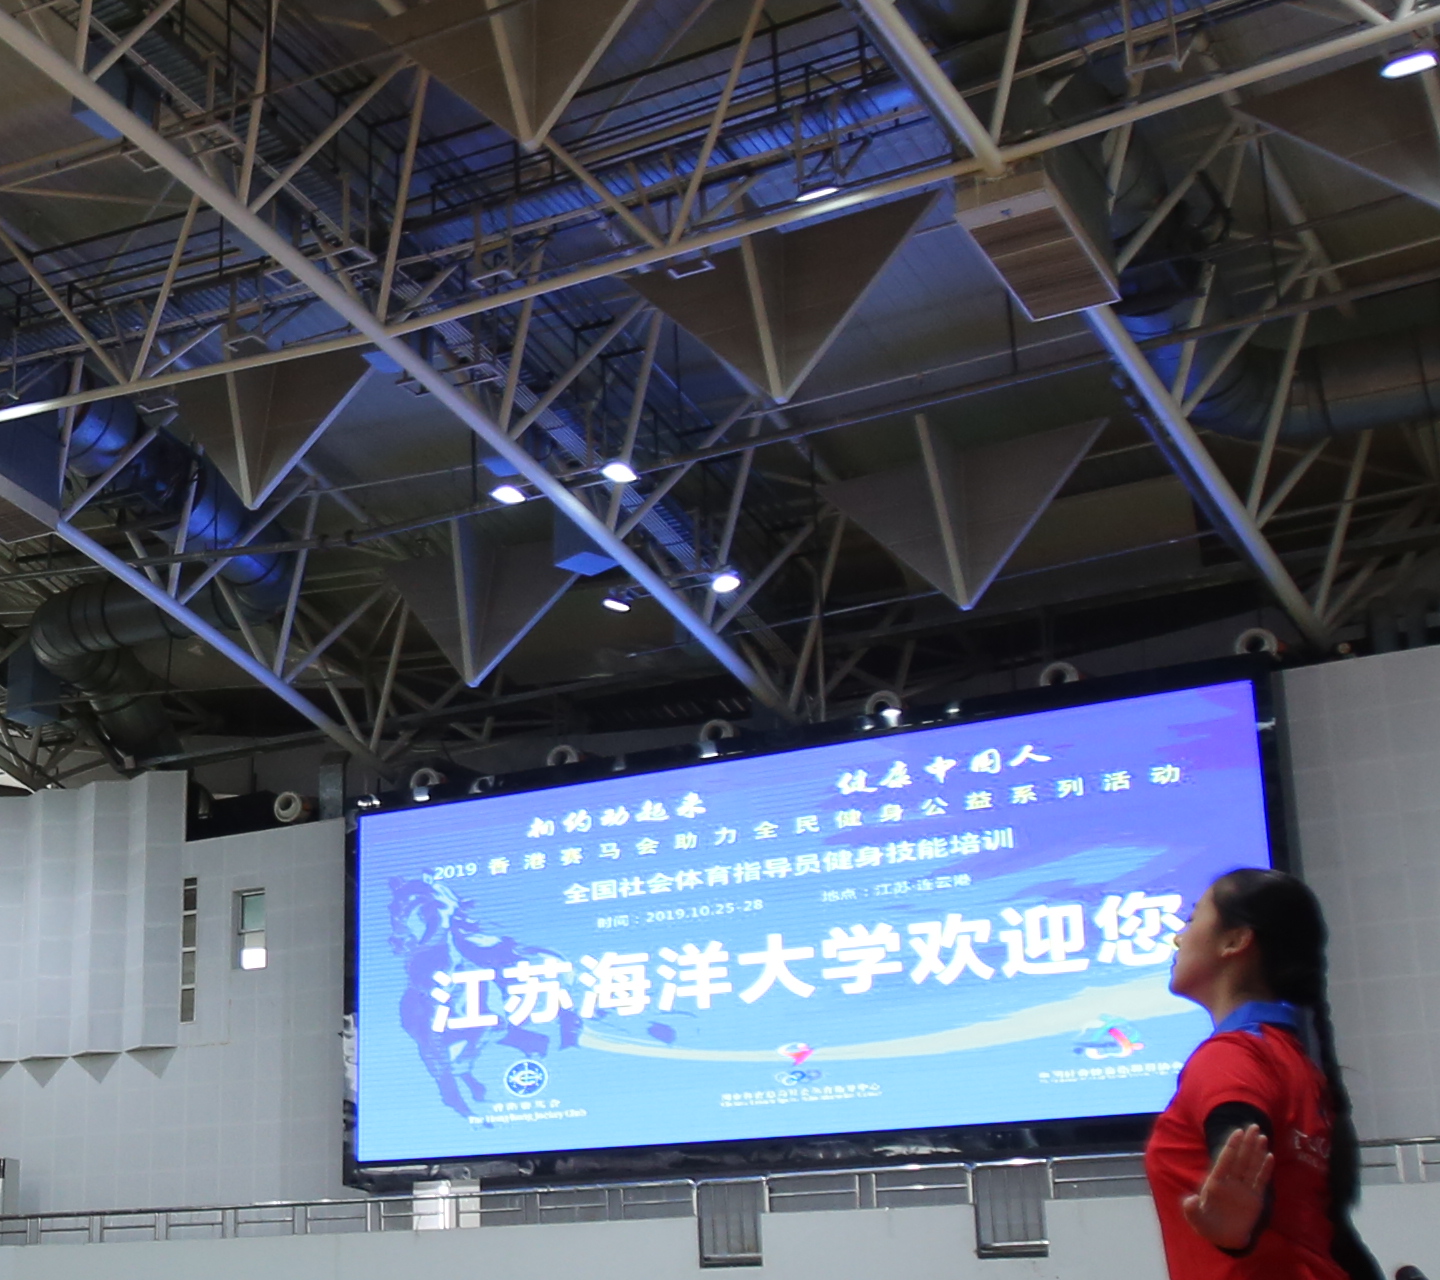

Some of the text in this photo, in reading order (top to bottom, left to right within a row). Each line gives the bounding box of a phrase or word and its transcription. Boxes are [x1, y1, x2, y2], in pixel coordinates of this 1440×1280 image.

[836, 744, 1052, 795] 健康中国人
[563, 827, 1015, 905] 全国社会体育指导员健身技能培训
[429, 890, 1188, 1032] 江苏海洋大学欢迎您
